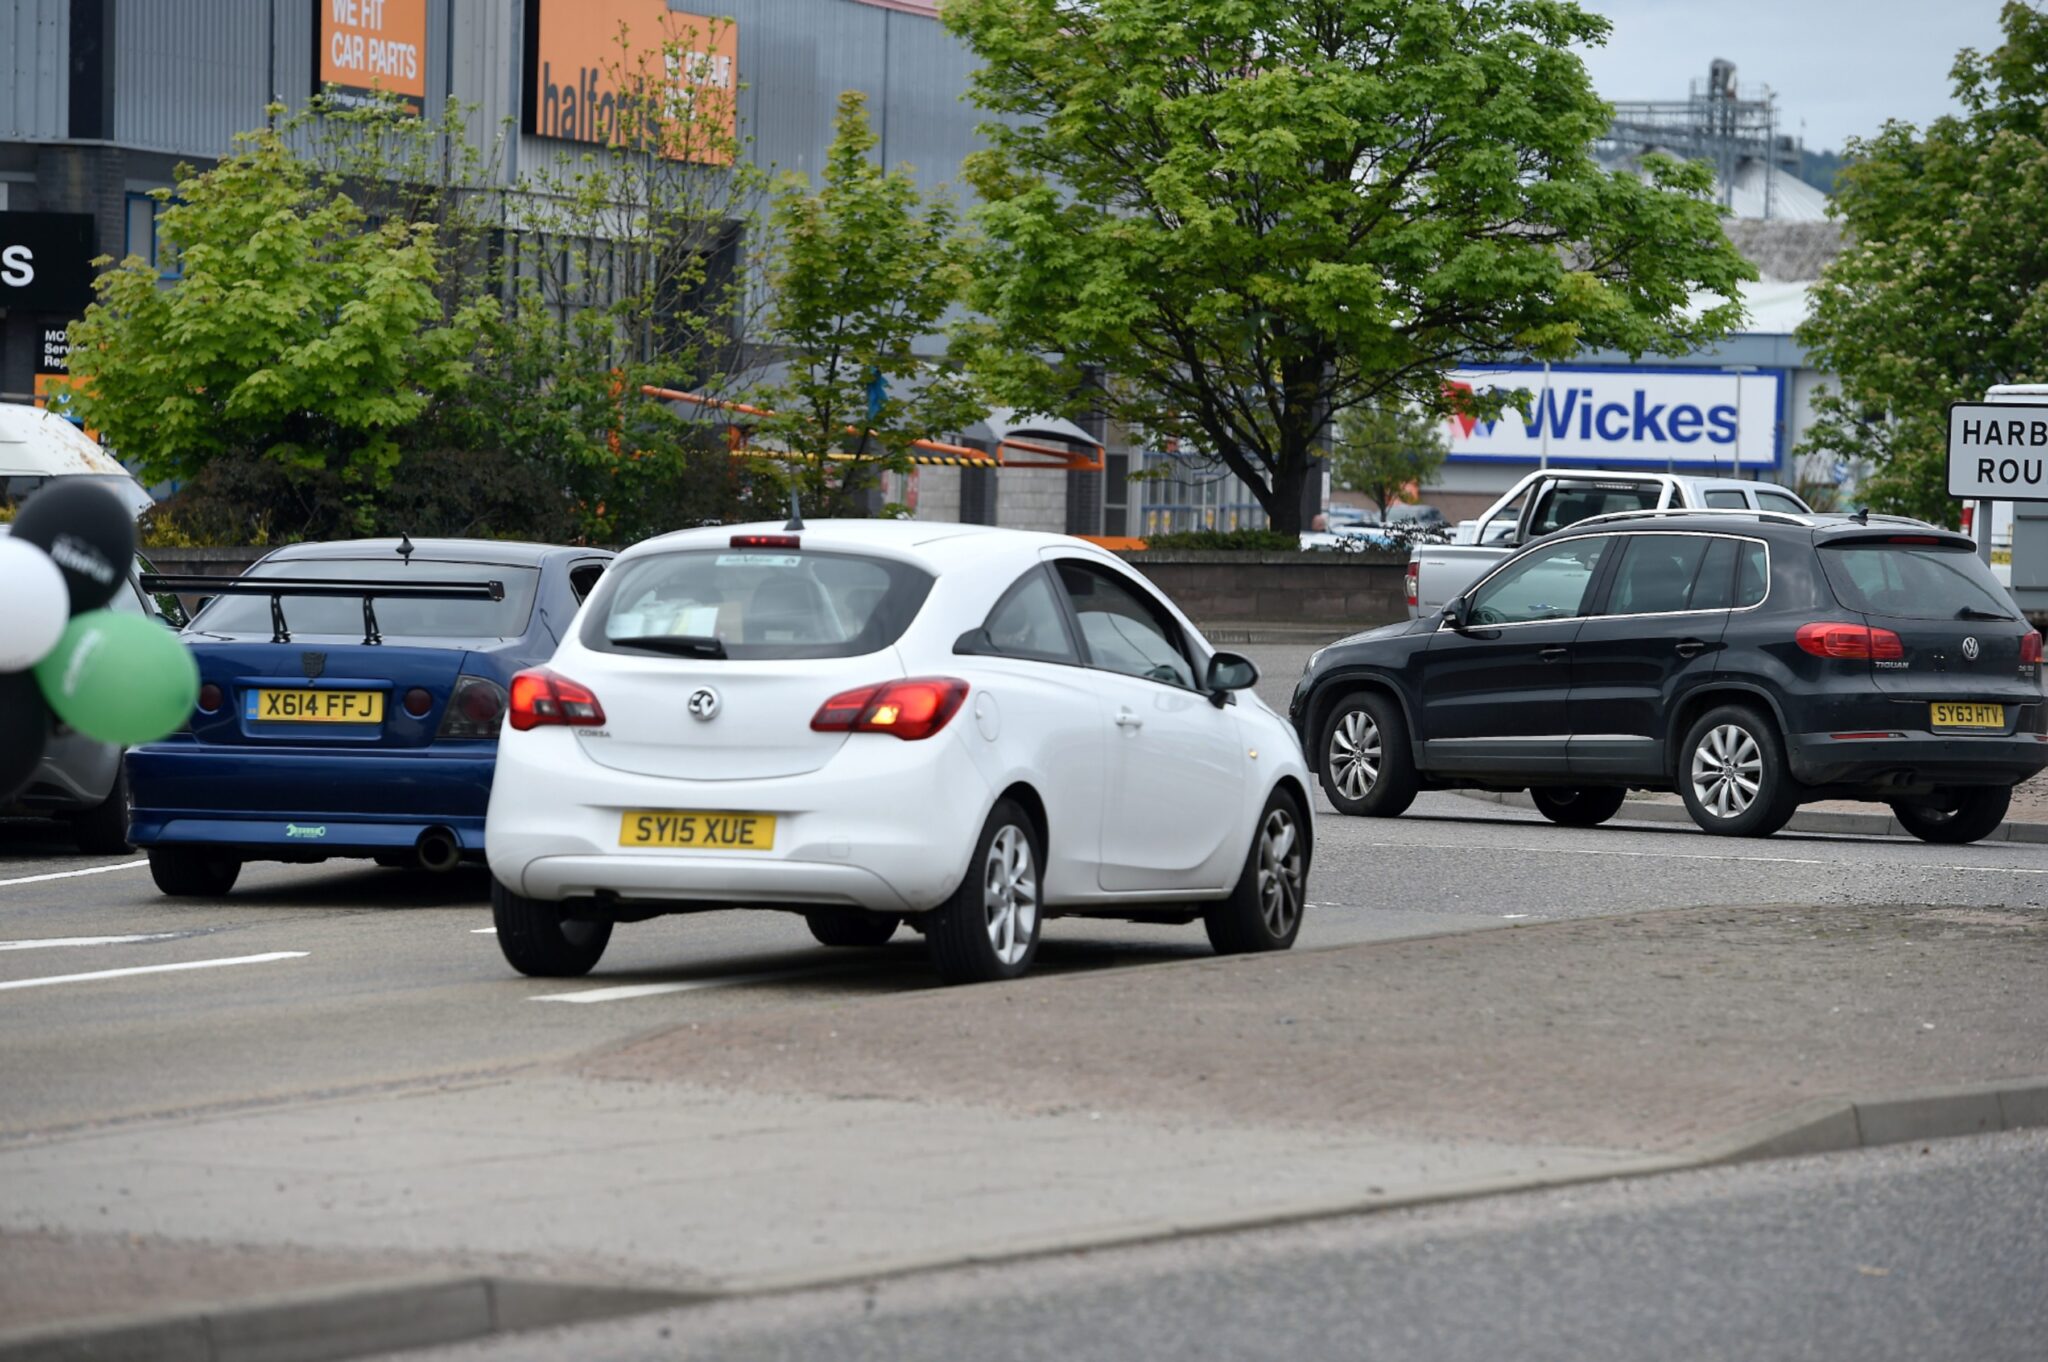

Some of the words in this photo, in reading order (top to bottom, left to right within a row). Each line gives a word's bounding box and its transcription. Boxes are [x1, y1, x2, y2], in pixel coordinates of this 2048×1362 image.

[332, 0, 357, 26] WE
[361, 0, 384, 31] FIT
[331, 31, 364, 71] CAR
[368, 38, 416, 79] PARTS
[45, 330, 68, 342] MO
[1516, 387, 1738, 444] Wickes
[1874, 661, 1909, 669] TIGUAN
[267, 693, 318, 716] X614
[326, 694, 372, 717] FFJ
[1937, 705, 1973, 722] SY63
[1976, 706, 1999, 724] HTV
[578, 729, 611, 738] CORSA
[636, 816, 696, 842] SY15
[703, 818, 757, 845] XUE
